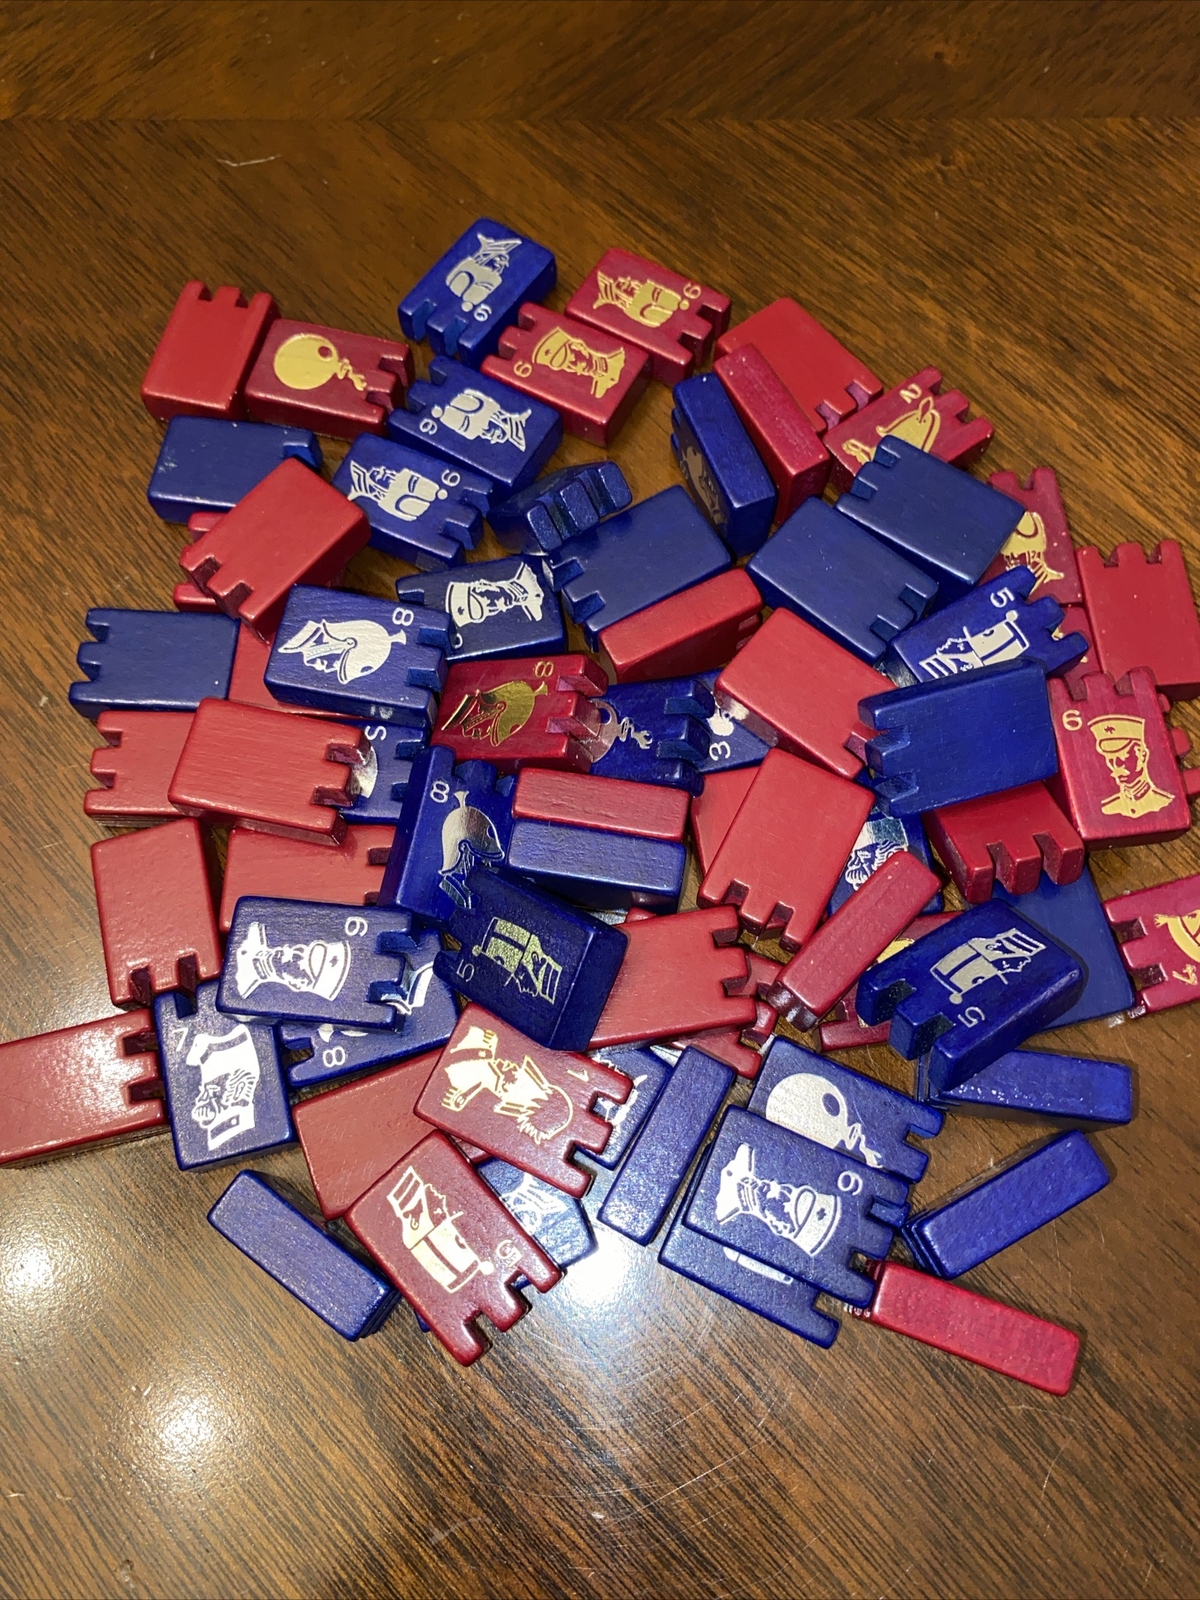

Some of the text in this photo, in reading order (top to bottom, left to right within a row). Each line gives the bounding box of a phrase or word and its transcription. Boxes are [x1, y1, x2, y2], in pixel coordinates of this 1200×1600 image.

[900, 383, 922, 404] 2
[990, 587, 1015, 608] 5
[391, 607, 414, 627] 8
[534, 660, 554, 678] 8
[1062, 709, 1083, 731] 6
[708, 741, 731, 760] 3
[429, 780, 450, 803] 8
[457, 959, 474, 982] 5
[958, 1006, 985, 1028] 5
[172, 1028, 188, 1051] 7
[322, 1046, 346, 1068] 8
[496, 1240, 521, 1267] 5
